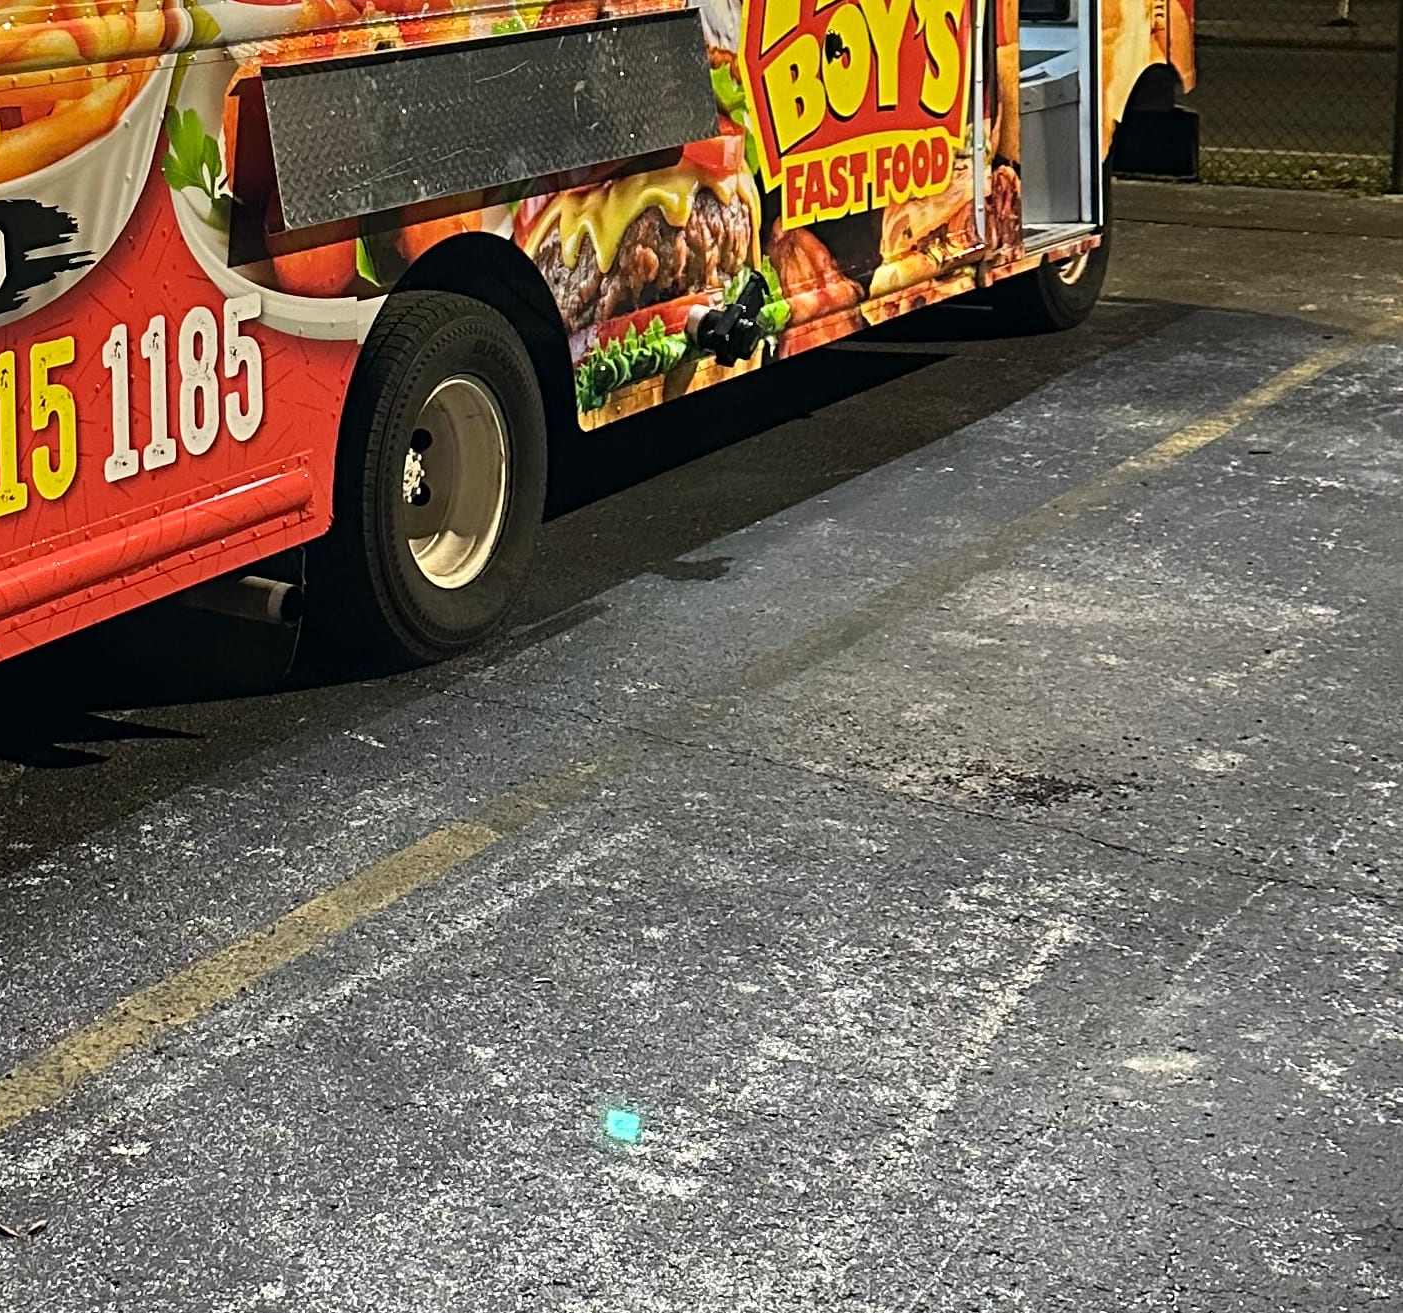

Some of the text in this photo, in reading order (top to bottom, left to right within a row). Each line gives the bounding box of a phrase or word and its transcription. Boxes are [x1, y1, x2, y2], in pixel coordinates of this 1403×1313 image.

[786, 136, 949, 218] FAST FOOD
[102, 294, 264, 484] 1185
